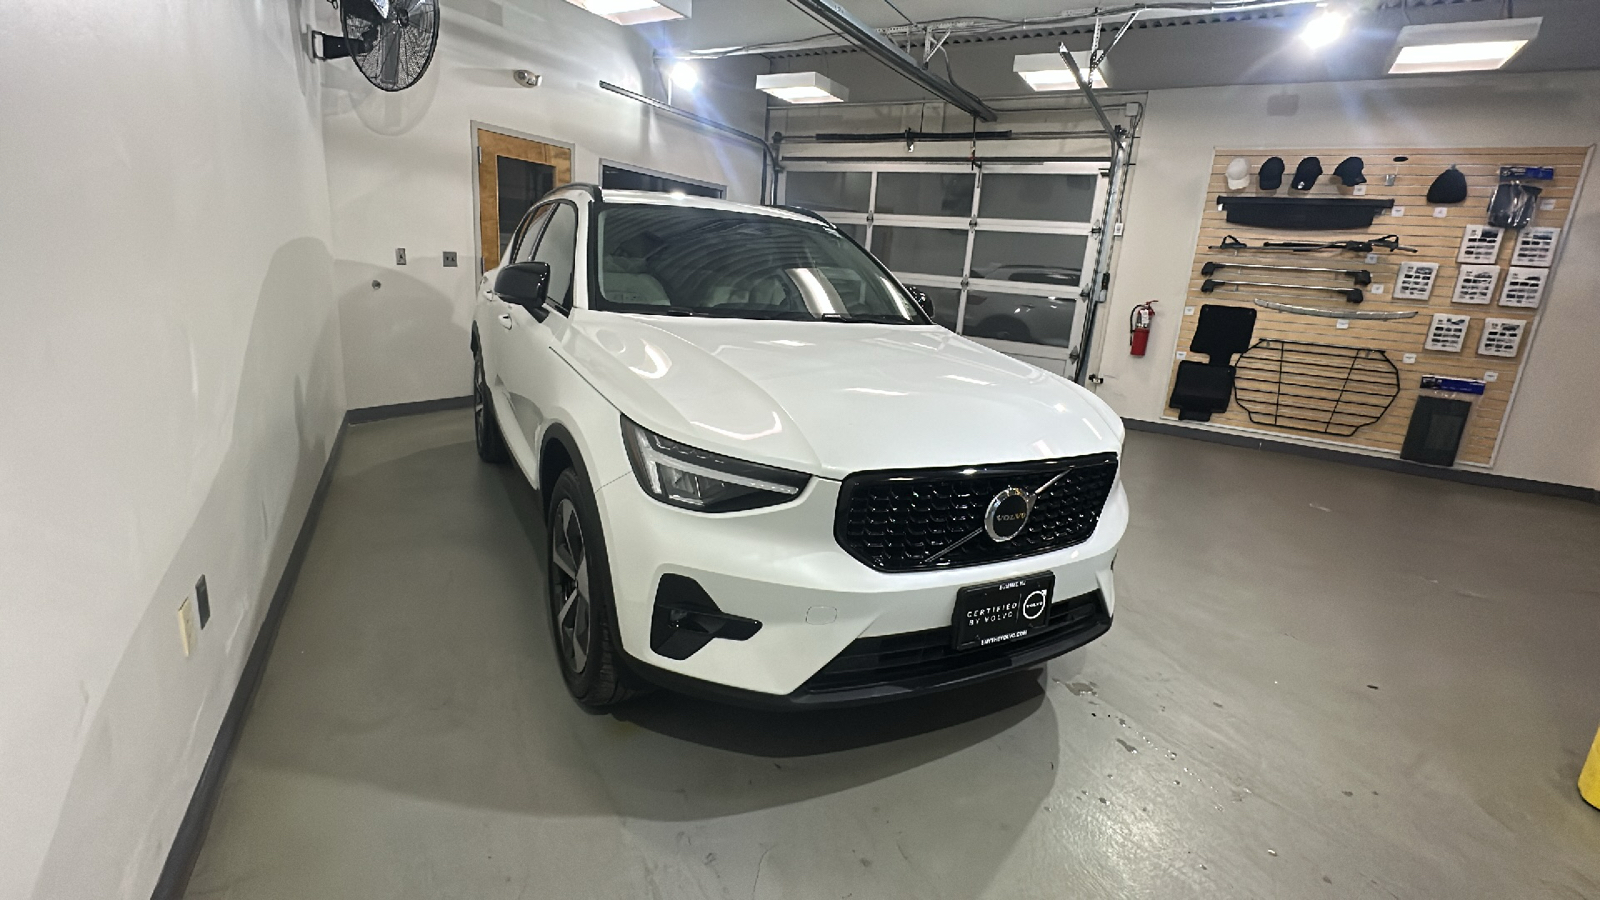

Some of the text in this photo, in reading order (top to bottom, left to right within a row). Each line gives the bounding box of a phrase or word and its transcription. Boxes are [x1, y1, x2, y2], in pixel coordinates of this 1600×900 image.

[996, 512, 1026, 521] VOLVO
[967, 602, 1017, 618] CERTIFIED
[968, 611, 1013, 626] BY VOLVO
